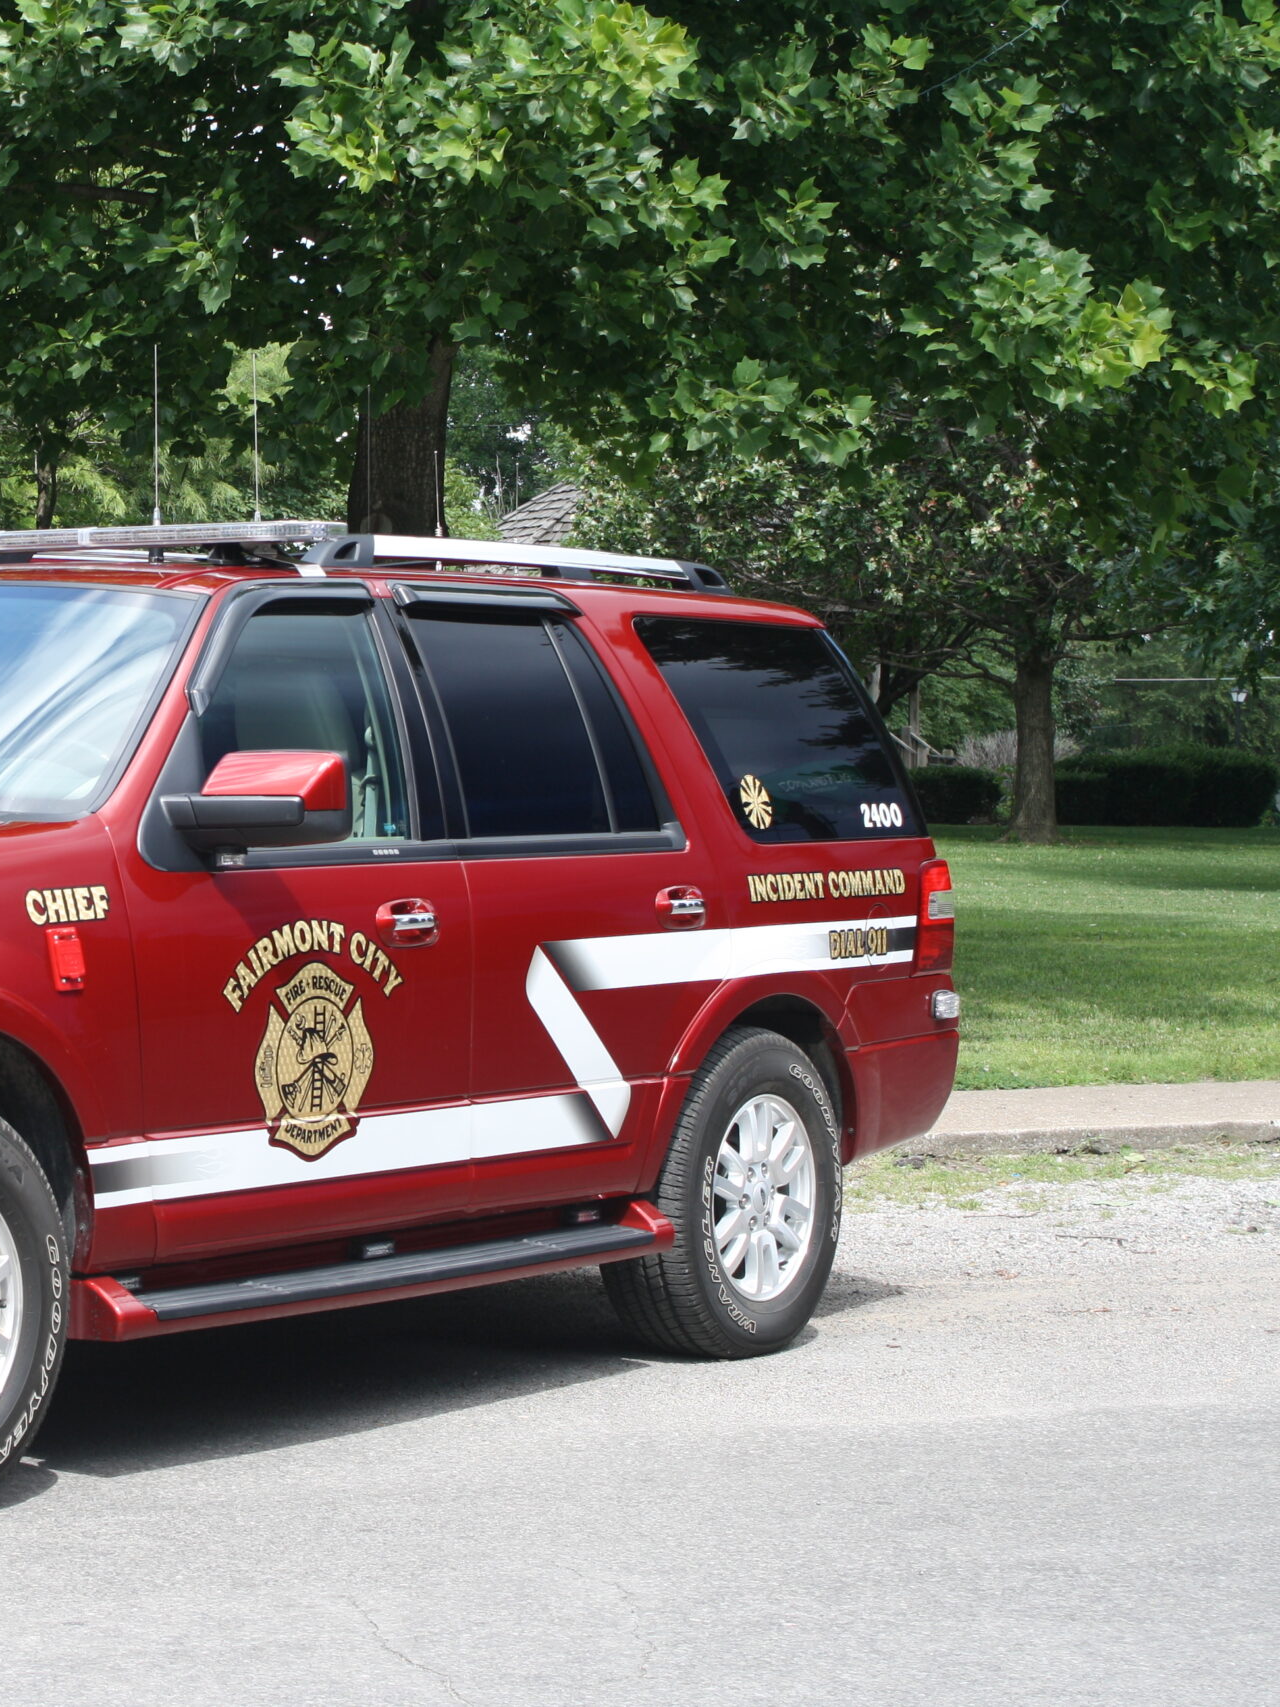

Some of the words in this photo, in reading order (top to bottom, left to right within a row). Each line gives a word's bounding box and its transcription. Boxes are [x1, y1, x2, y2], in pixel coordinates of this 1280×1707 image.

[860, 802, 903, 828] 2400
[747, 872, 825, 903] INCIDENT
[827, 868, 906, 898] COMMAND
[24, 885, 109, 926] CHIEF
[829, 929, 864, 960] DIAL
[865, 926, 887, 956] 911
[222, 919, 346, 1014] FAIRMONT
[348, 931, 404, 998] CITY
[284, 983, 306, 1006] FIRE
[312, 975, 348, 1000] RESCUE
[284, 1118, 342, 1144] DEPARTMENT
[789, 1063, 843, 1242] GOODYEAR
[701, 1155, 757, 1334] WRANGLER
